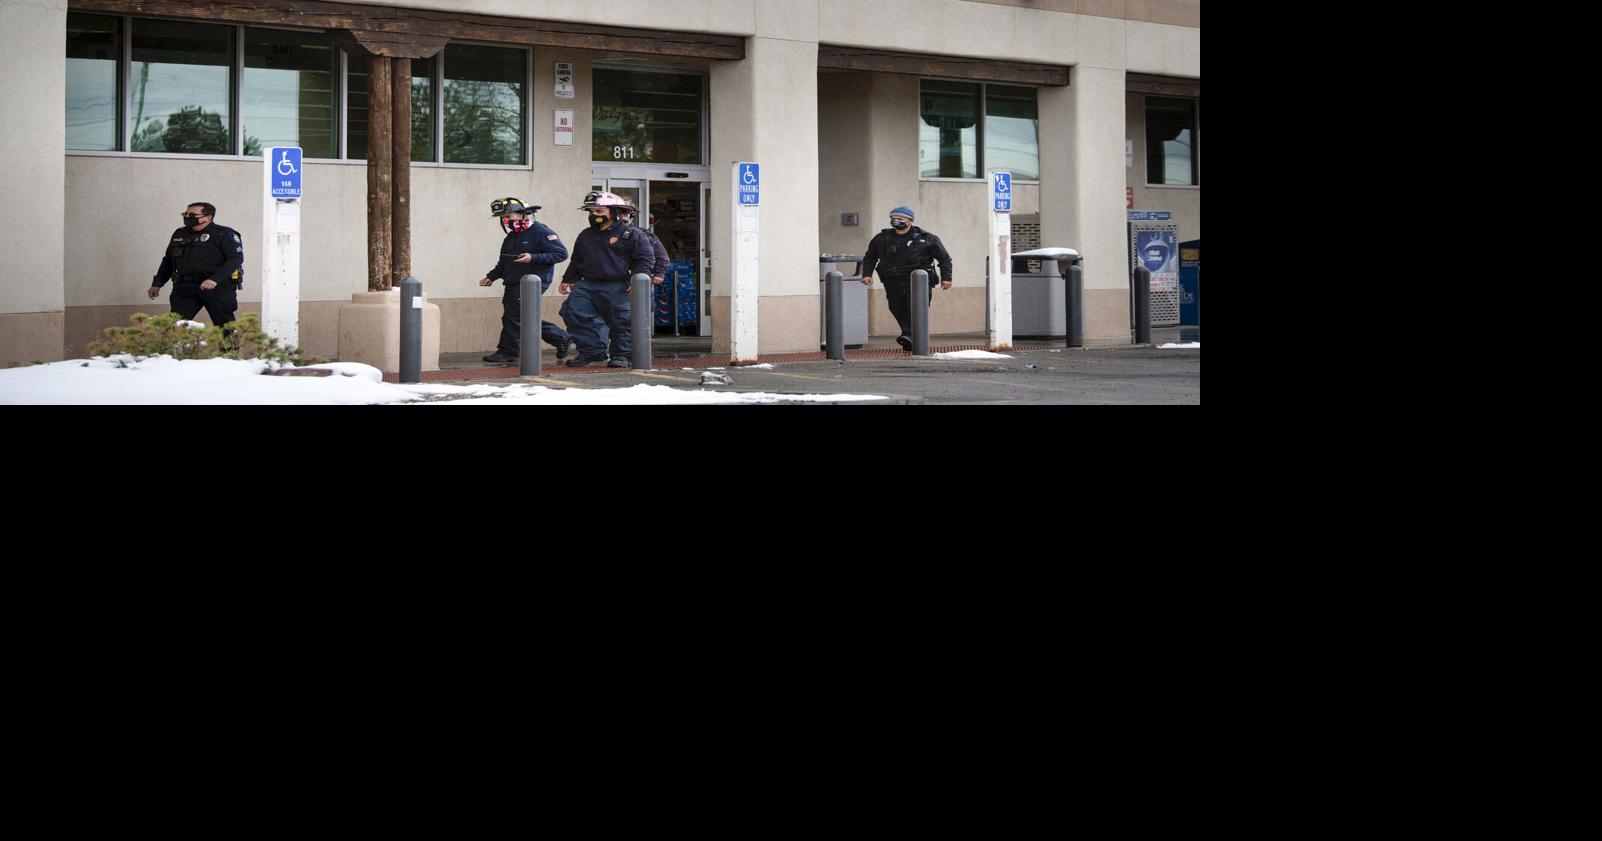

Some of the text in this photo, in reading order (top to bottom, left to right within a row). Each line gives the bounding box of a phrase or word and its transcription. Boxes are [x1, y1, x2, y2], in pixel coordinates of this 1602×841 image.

[560, 118, 568, 126] NO
[613, 145, 634, 159] 811
[739, 184, 760, 192] PARKING
[742, 194, 756, 202] ONLY
